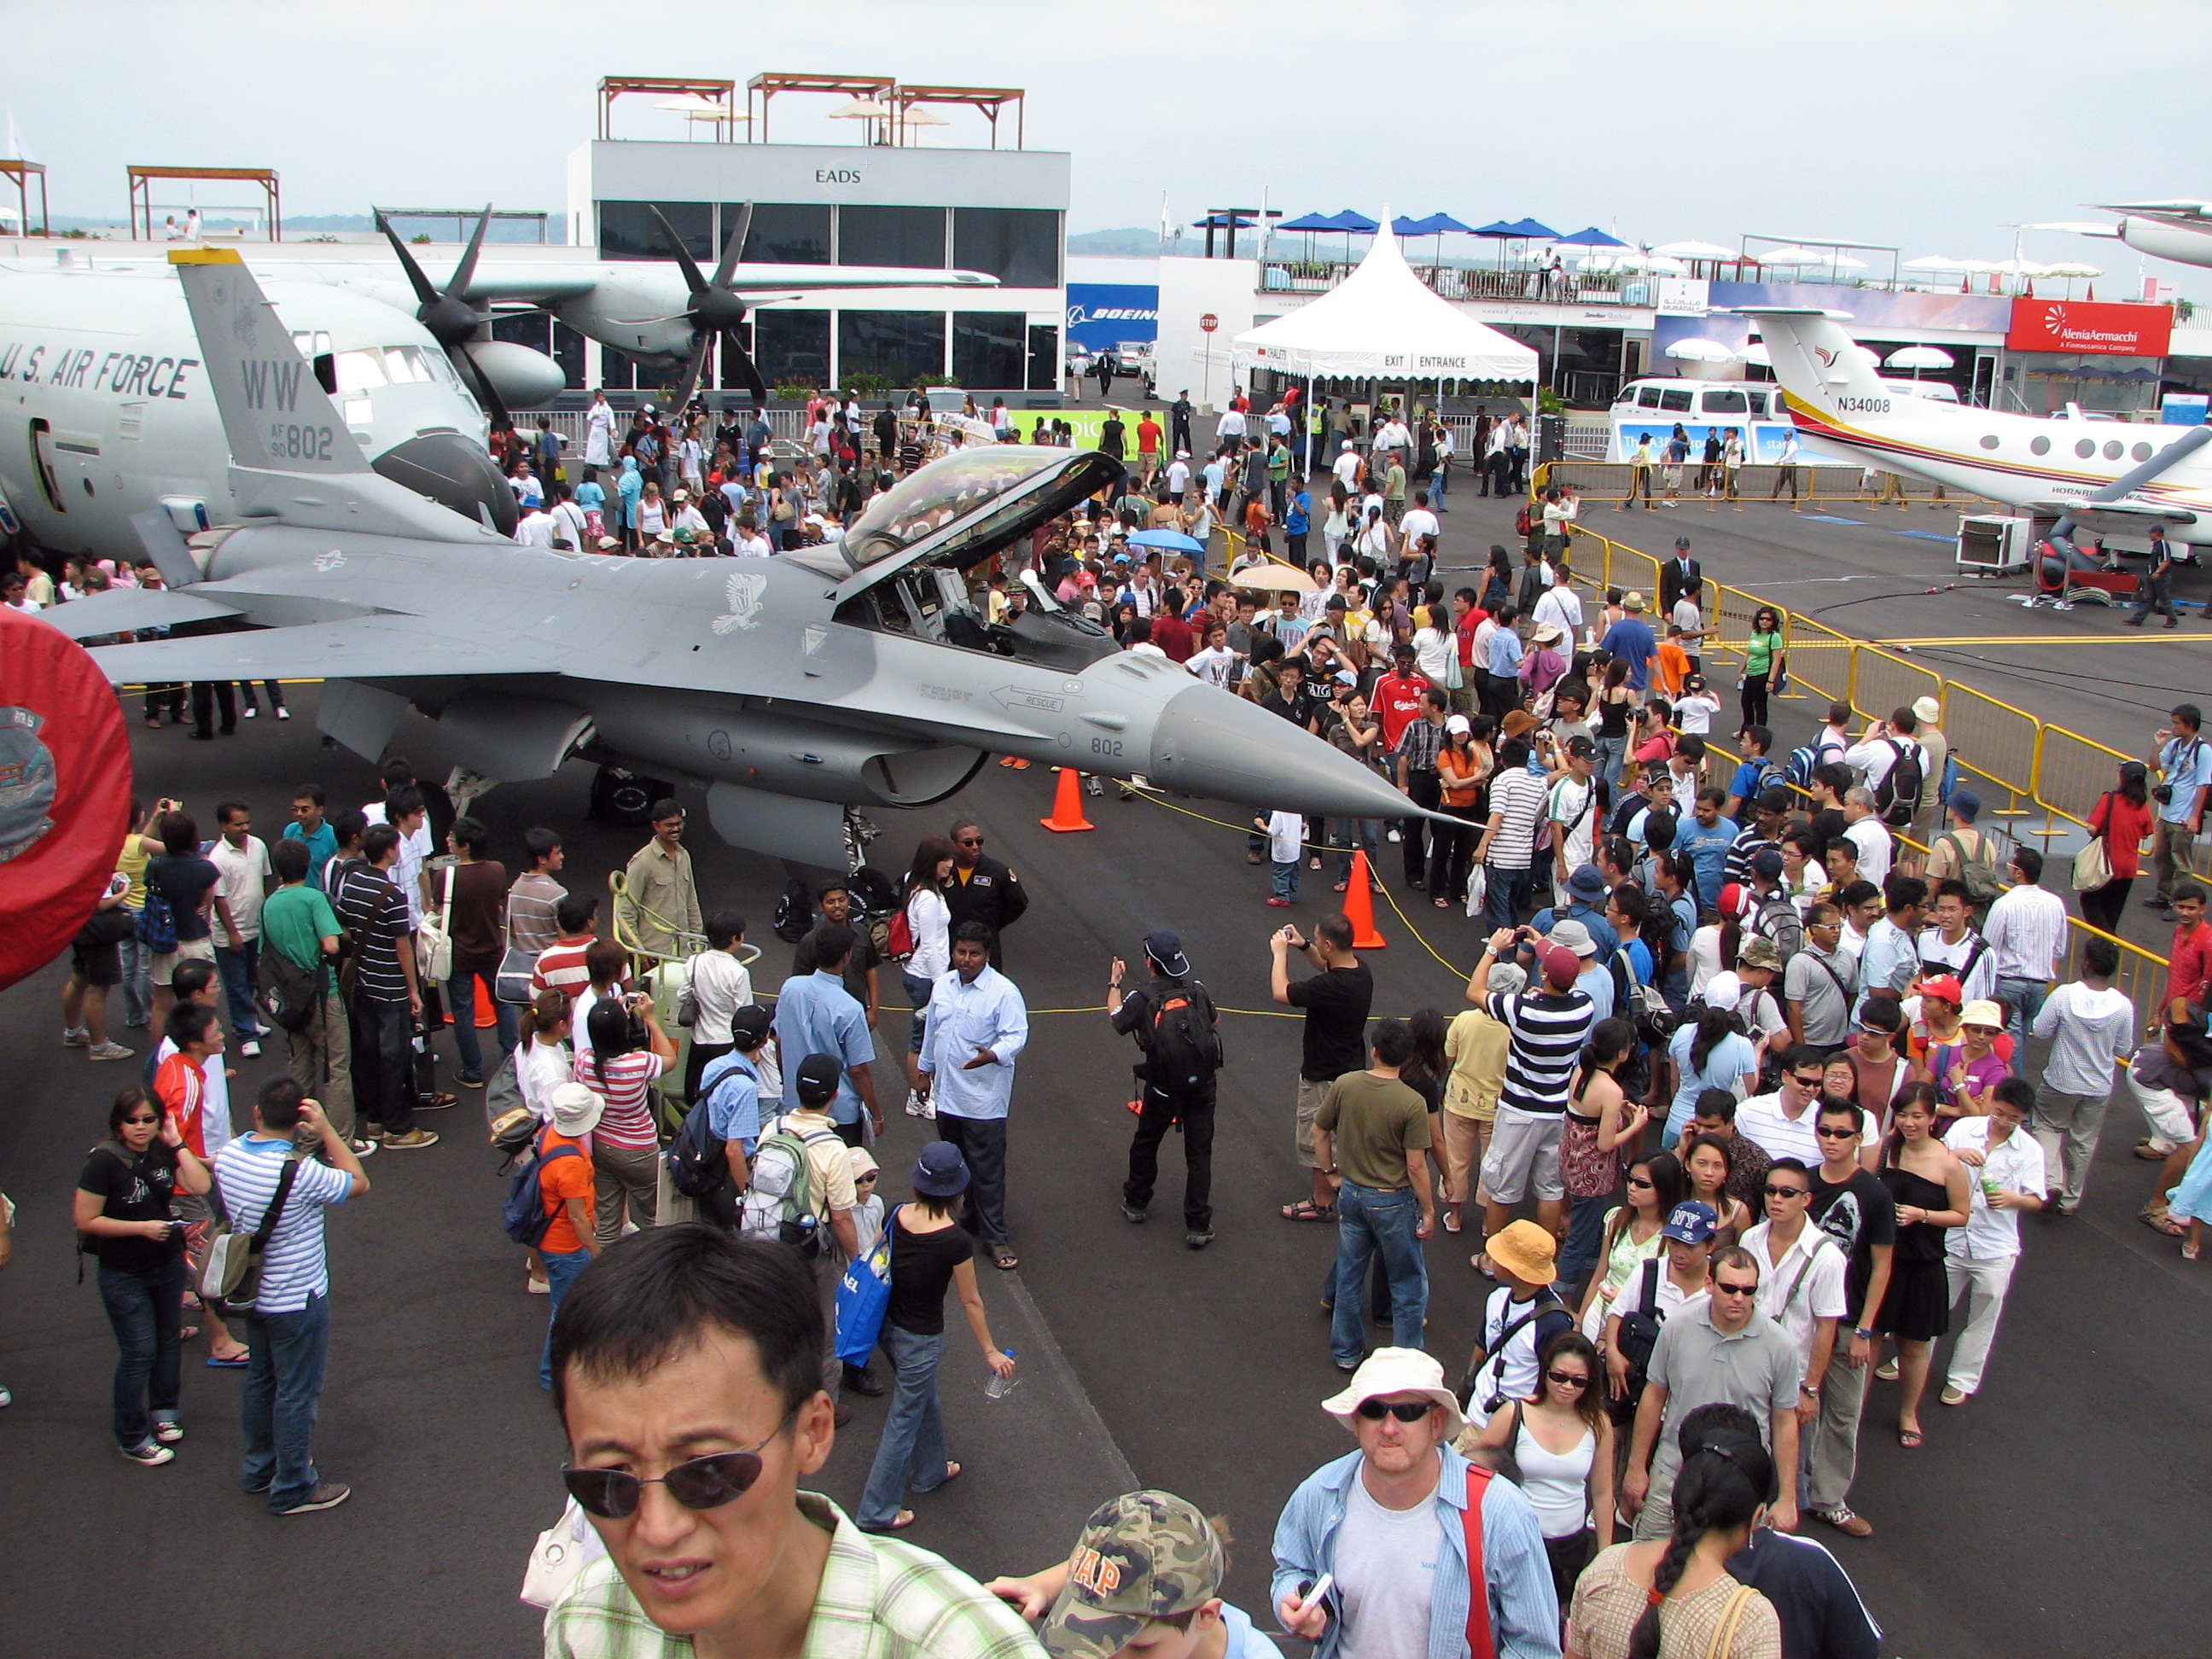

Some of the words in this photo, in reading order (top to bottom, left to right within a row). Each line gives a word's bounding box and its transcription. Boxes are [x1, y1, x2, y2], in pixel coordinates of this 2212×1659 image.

[815, 169, 861, 183] EADS
[1201, 318, 1218, 328] STOP
[2060, 328, 2139, 343] AleniaAermacchi
[2108, 343, 2137, 352] Company
[1384, 355, 1405, 367] EXIT
[1419, 356, 1467, 369] ENTRANCE
[23, 345, 46, 383] S.
[49, 347, 96, 389] AIR
[94, 352, 201, 400] FORCE
[242, 359, 304, 412] WW
[1837, 396, 1891, 413] N34008
[271, 423, 285, 438] AF
[286, 424, 333, 462] 802
[1026, 696, 1057, 709] RESCUE
[1091, 737, 1124, 758] 802
[1670, 1209, 1701, 1230] NY
